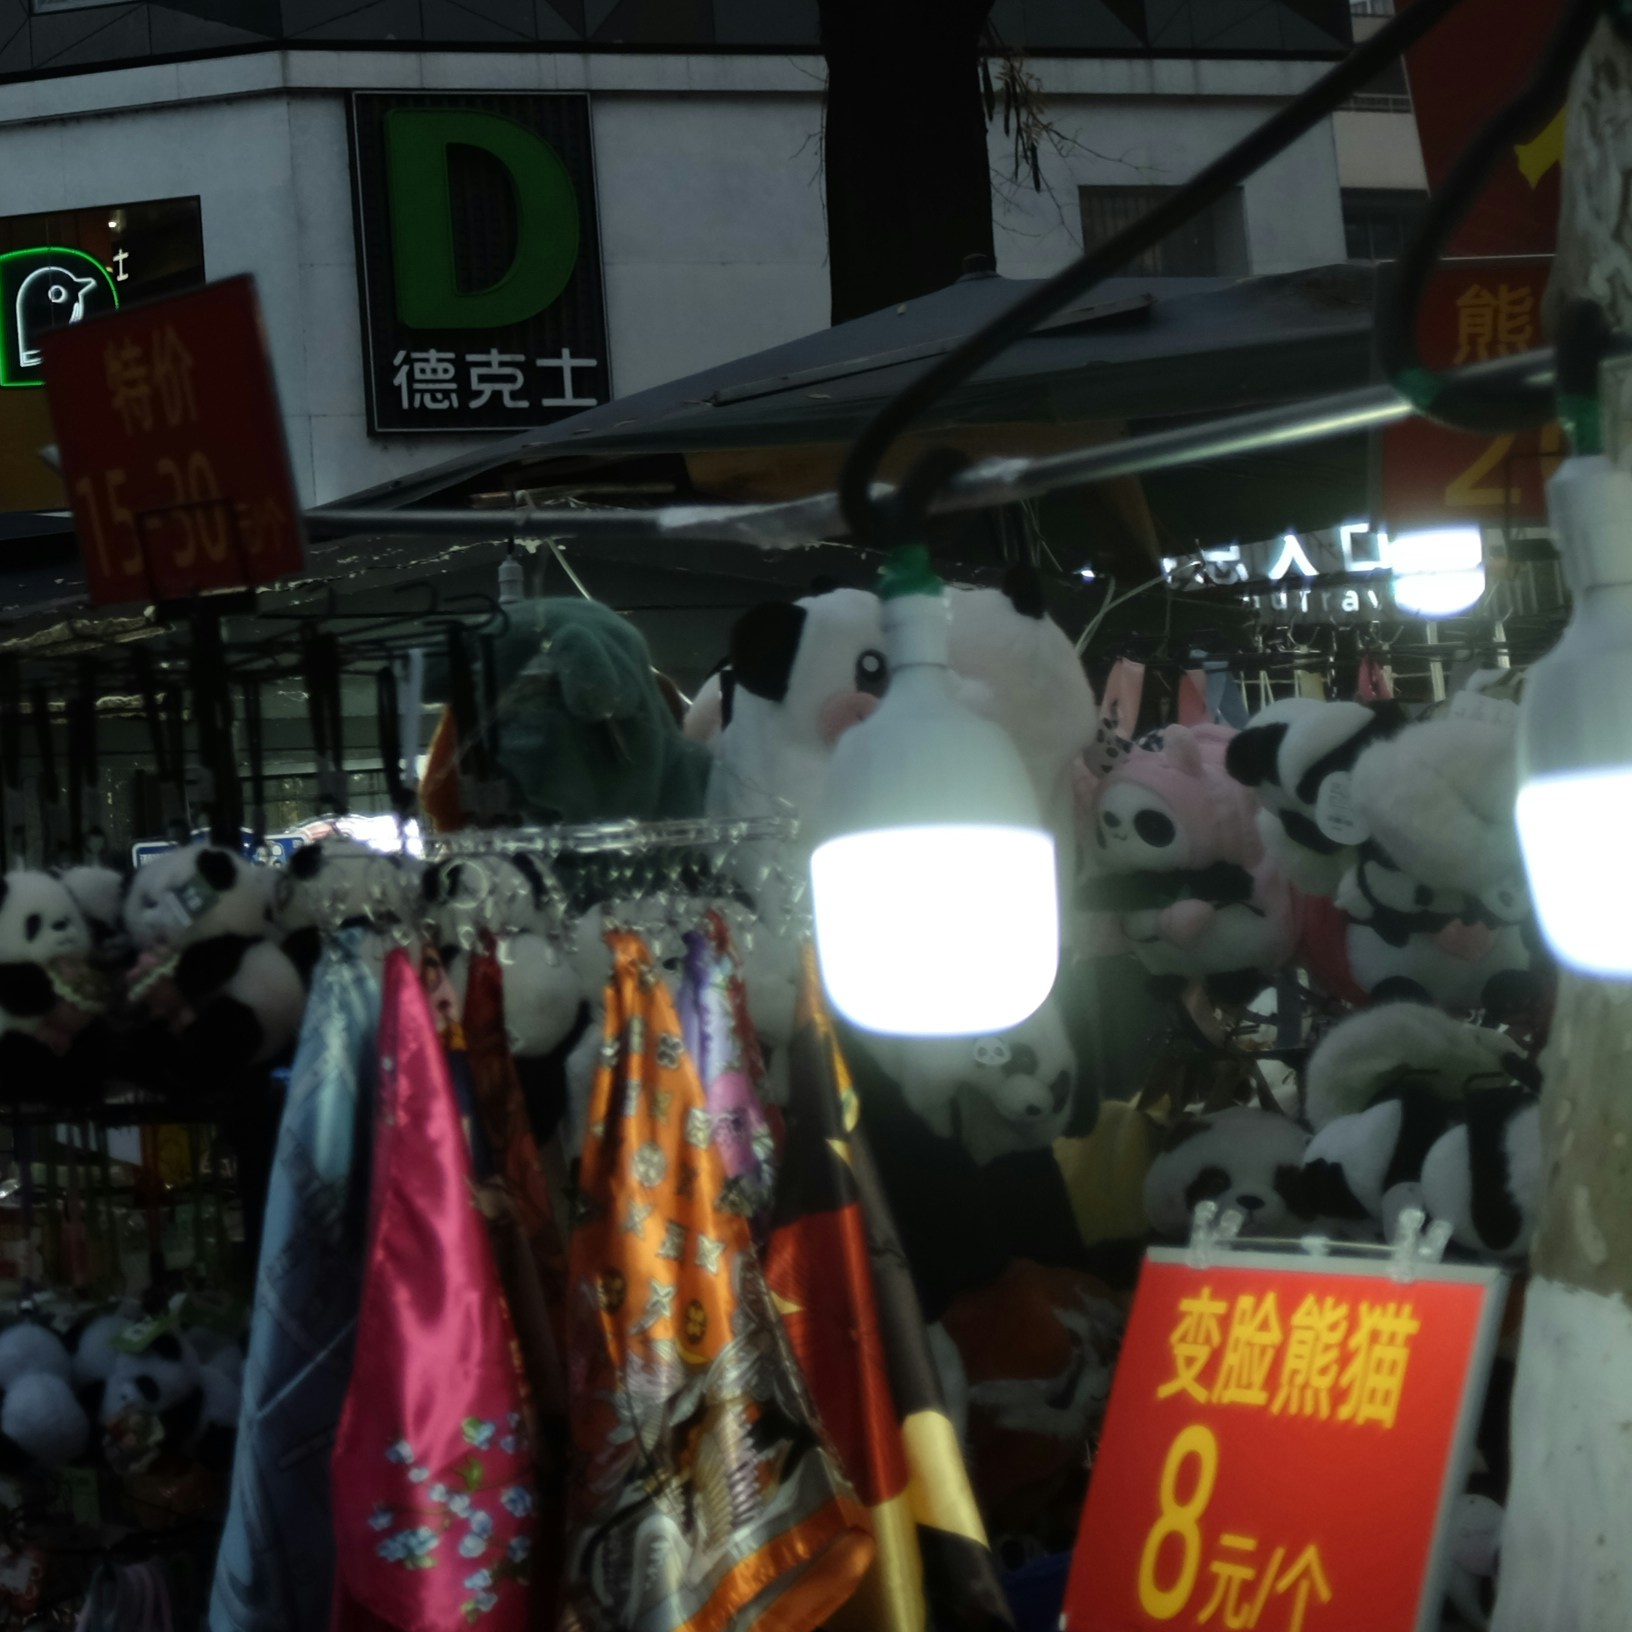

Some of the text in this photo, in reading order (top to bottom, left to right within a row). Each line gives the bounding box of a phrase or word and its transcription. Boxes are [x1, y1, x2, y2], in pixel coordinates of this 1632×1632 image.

[383, 107, 579, 330] D
[103, 323, 200, 438] 特价
[391, 346, 599, 411] 德克士
[1154, 1285, 1421, 1431] 变脸熊猫
[1136, 1423, 1333, 1632] 8元/个
